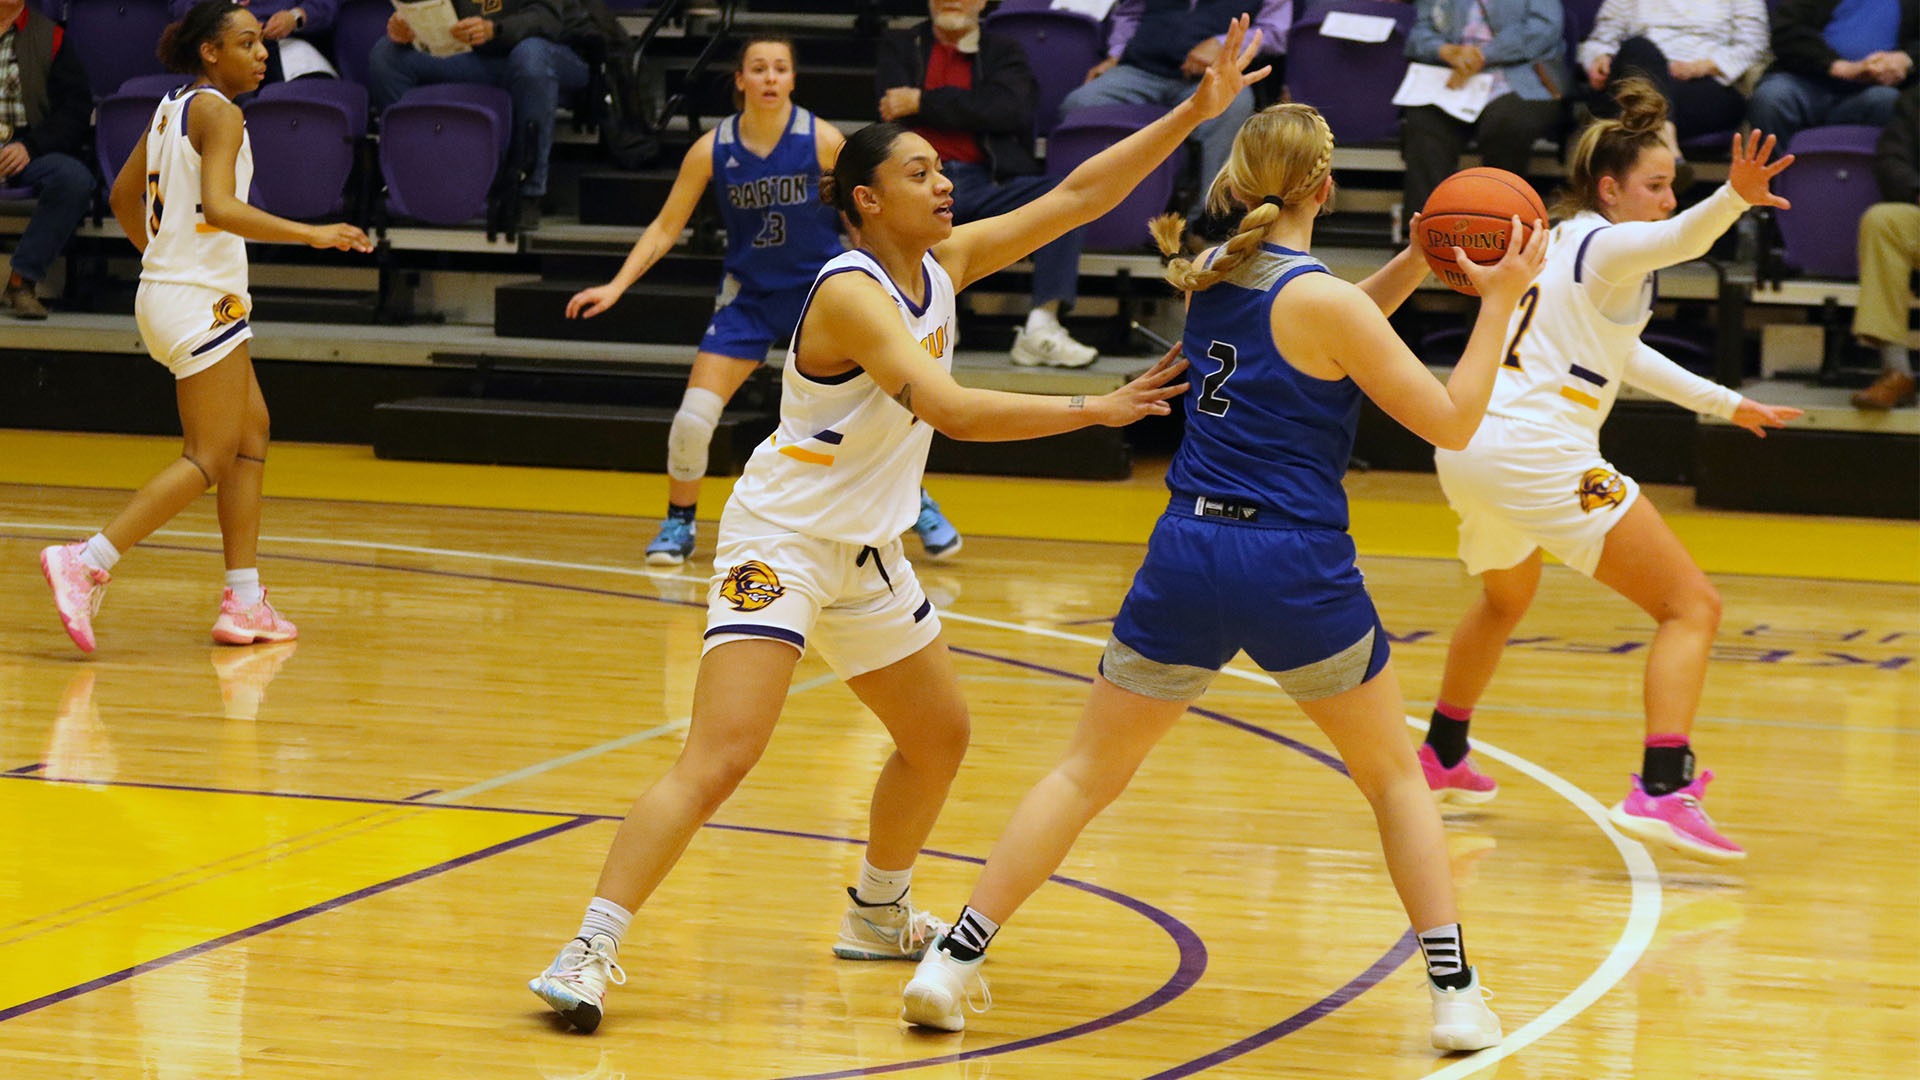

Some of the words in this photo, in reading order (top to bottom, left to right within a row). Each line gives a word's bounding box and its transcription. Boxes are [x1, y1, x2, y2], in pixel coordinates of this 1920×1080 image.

[727, 174, 808, 209] BARTON
[752, 211, 786, 248] 23
[1427, 228, 1505, 251] SPALDING
[1444, 269, 1473, 286] NJC
[1501, 282, 1541, 373] 2
[1197, 340, 1238, 418] 2
